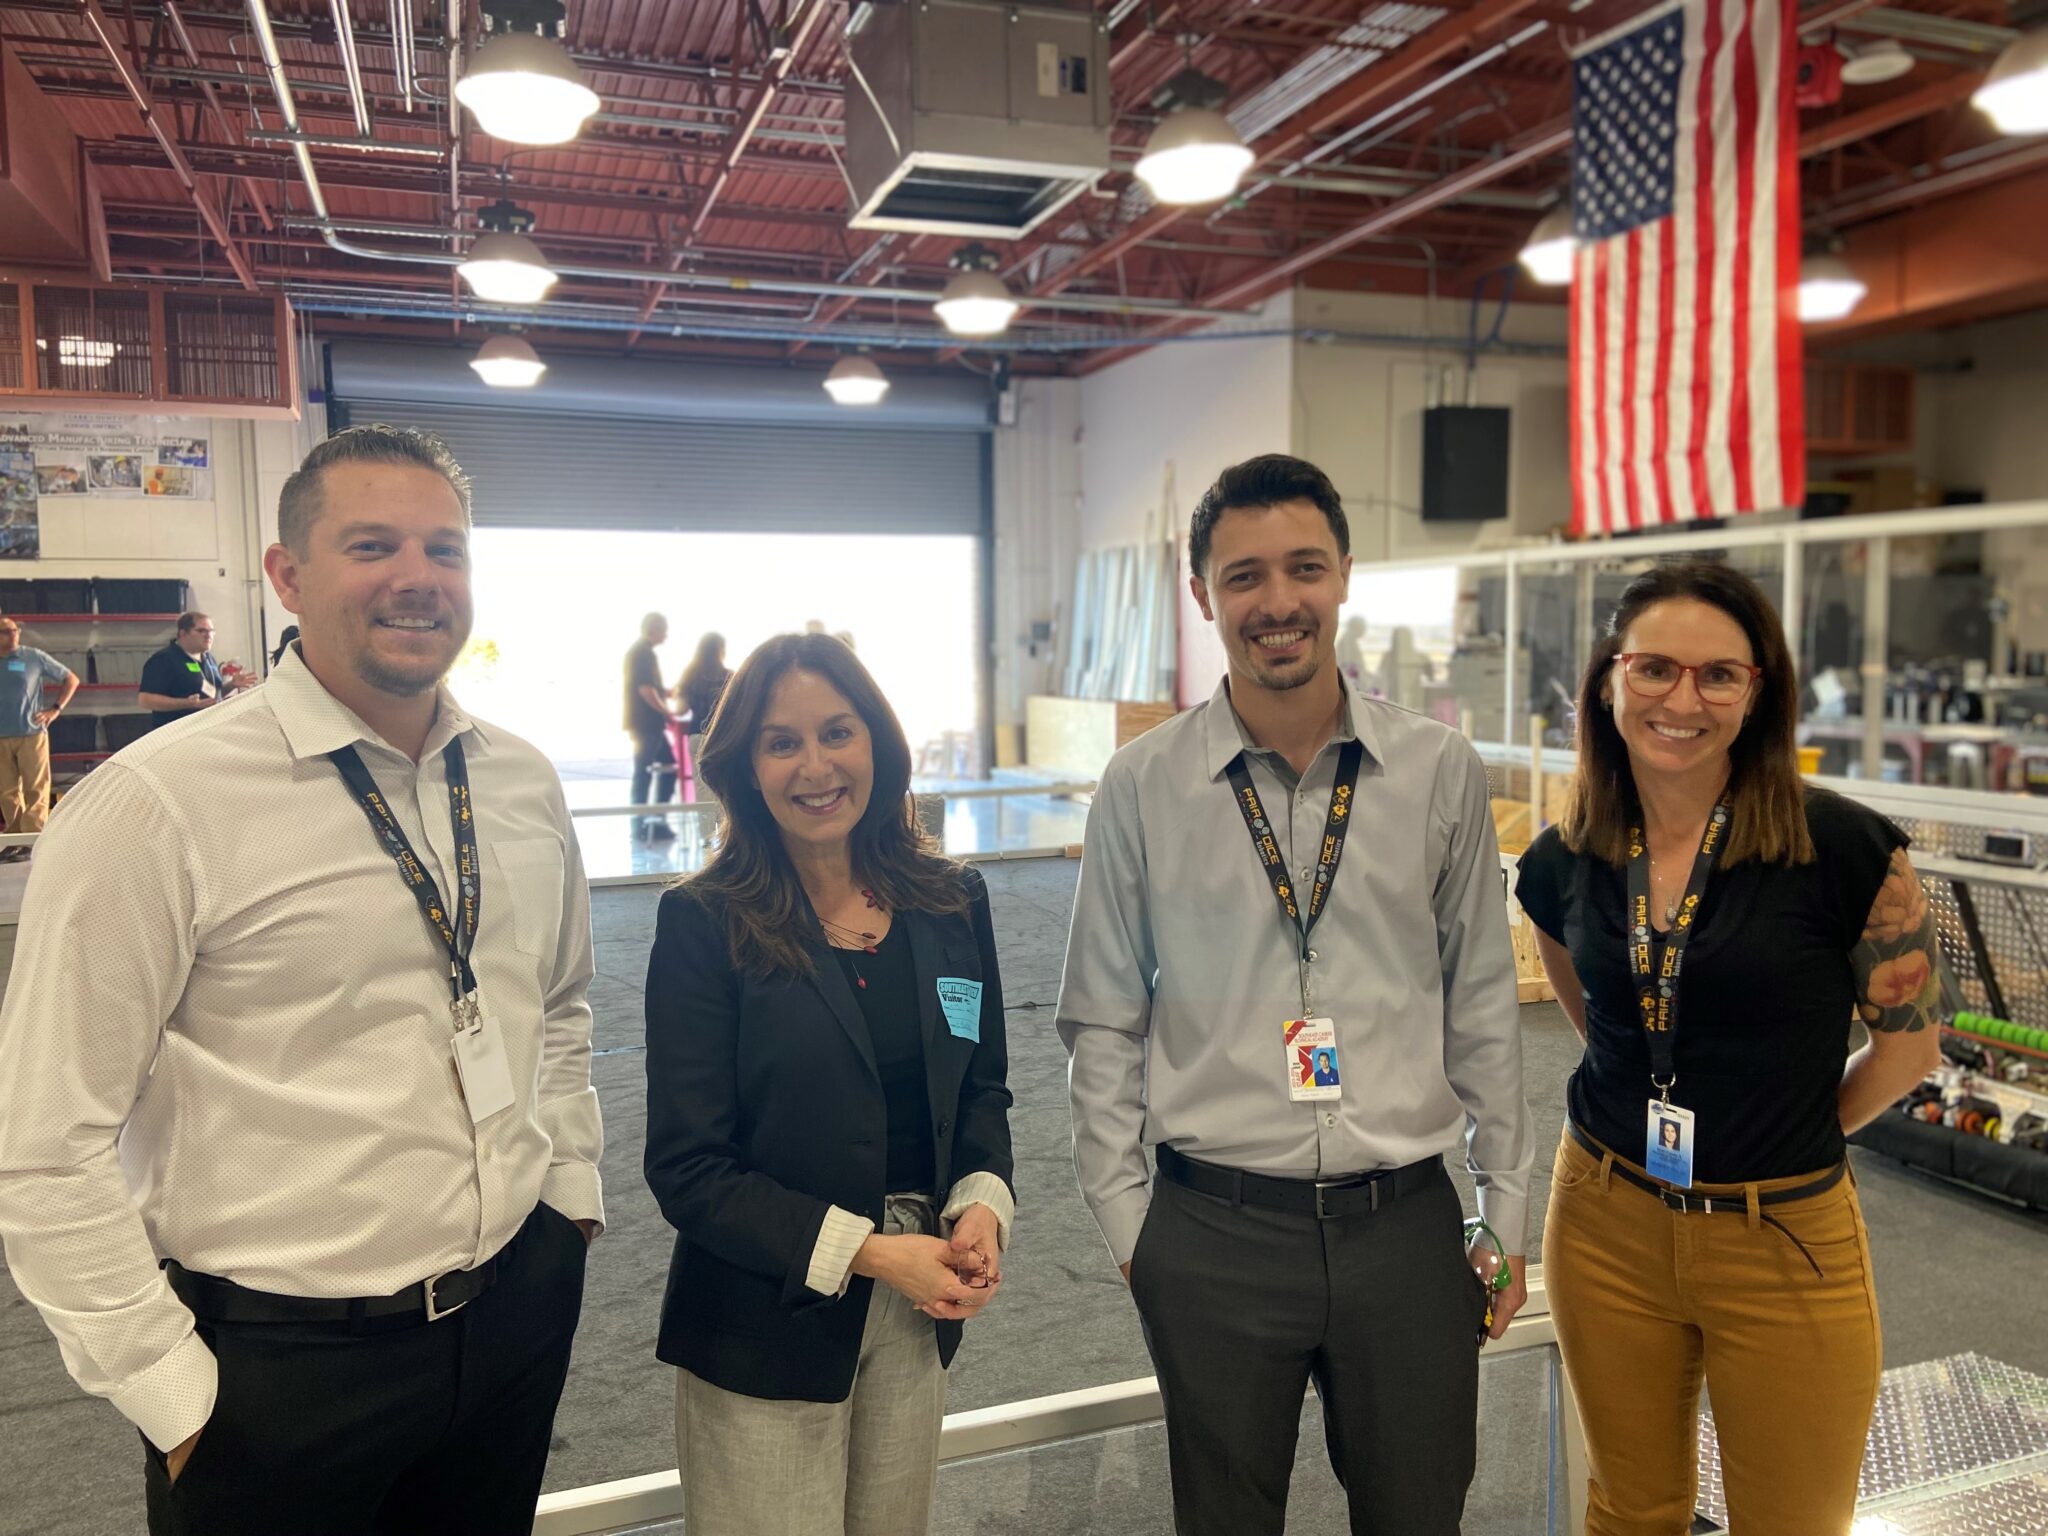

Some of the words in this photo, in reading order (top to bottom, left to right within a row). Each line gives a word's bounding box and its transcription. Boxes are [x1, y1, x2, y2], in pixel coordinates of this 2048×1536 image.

[1243, 787, 1262, 819] PAIR
[1262, 835, 1280, 865] DICE
[1702, 822, 1720, 854] PAIR
[401, 849, 425, 888] DICE
[1310, 883, 1323, 916] PAIR
[1321, 834, 1336, 865] DICE
[1636, 895, 1647, 926] PAIR
[1637, 943, 1651, 975] DICE
[1661, 946, 1677, 977] DICE
[1658, 998, 1670, 1032] PAIR
